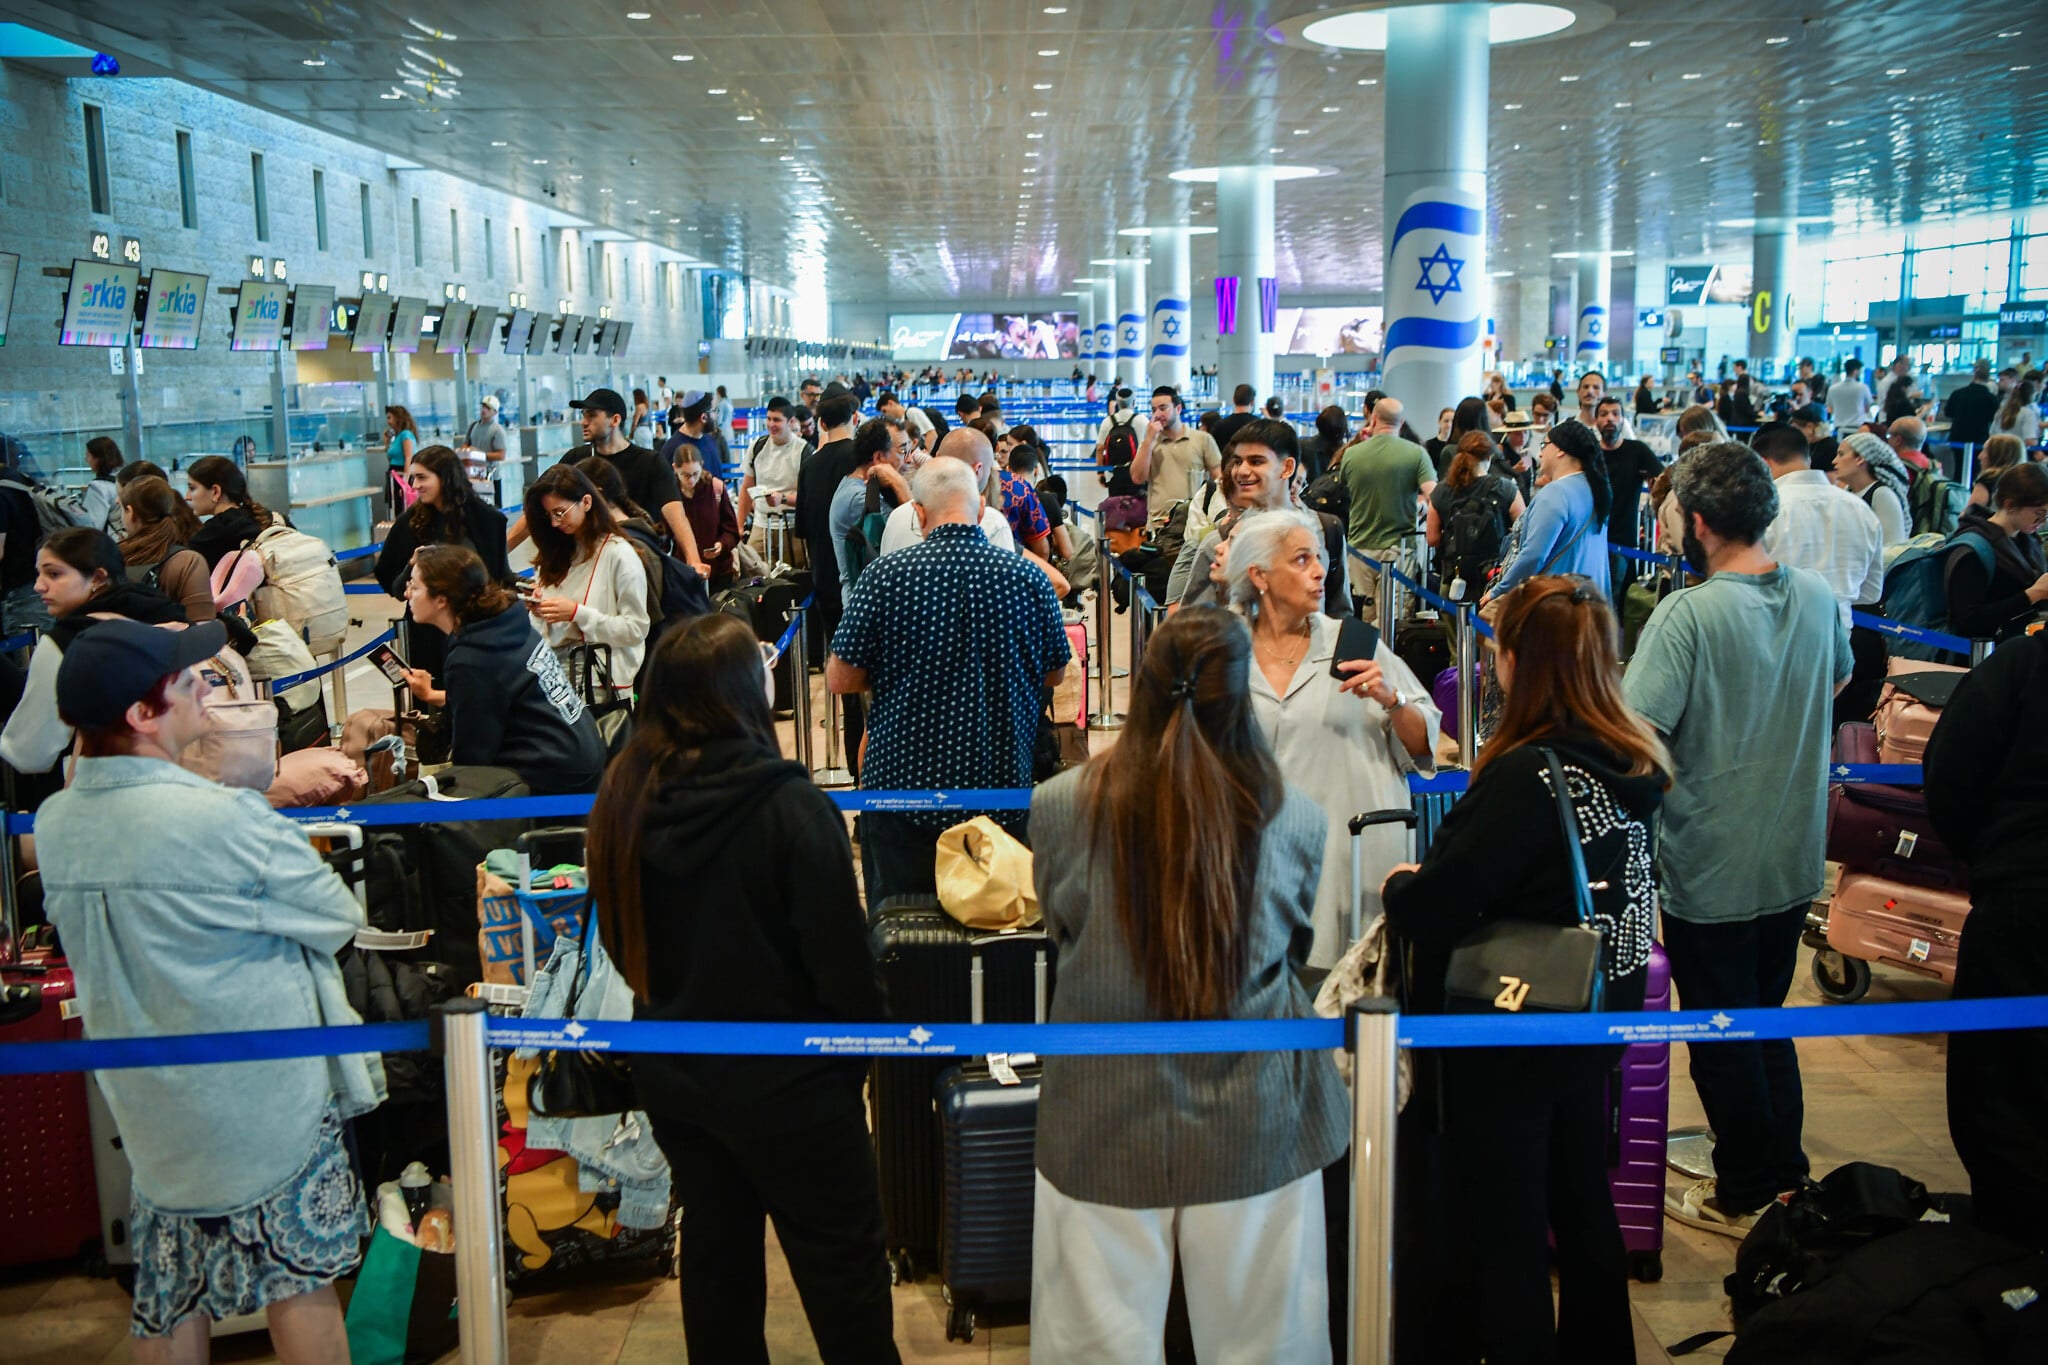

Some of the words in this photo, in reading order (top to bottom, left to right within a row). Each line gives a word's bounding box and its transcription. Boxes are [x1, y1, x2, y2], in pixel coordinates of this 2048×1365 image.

[92, 234, 110, 259] 42
[124, 240, 141, 263] 43
[251, 258, 264, 278] 44
[80, 275, 127, 310] arkia
[158, 282, 197, 315] arkia
[246, 291, 280, 320] arkia
[1753, 290, 1772, 334] C
[2000, 311, 2013, 323] TAX
[2014, 309, 2046, 323] REFUND
